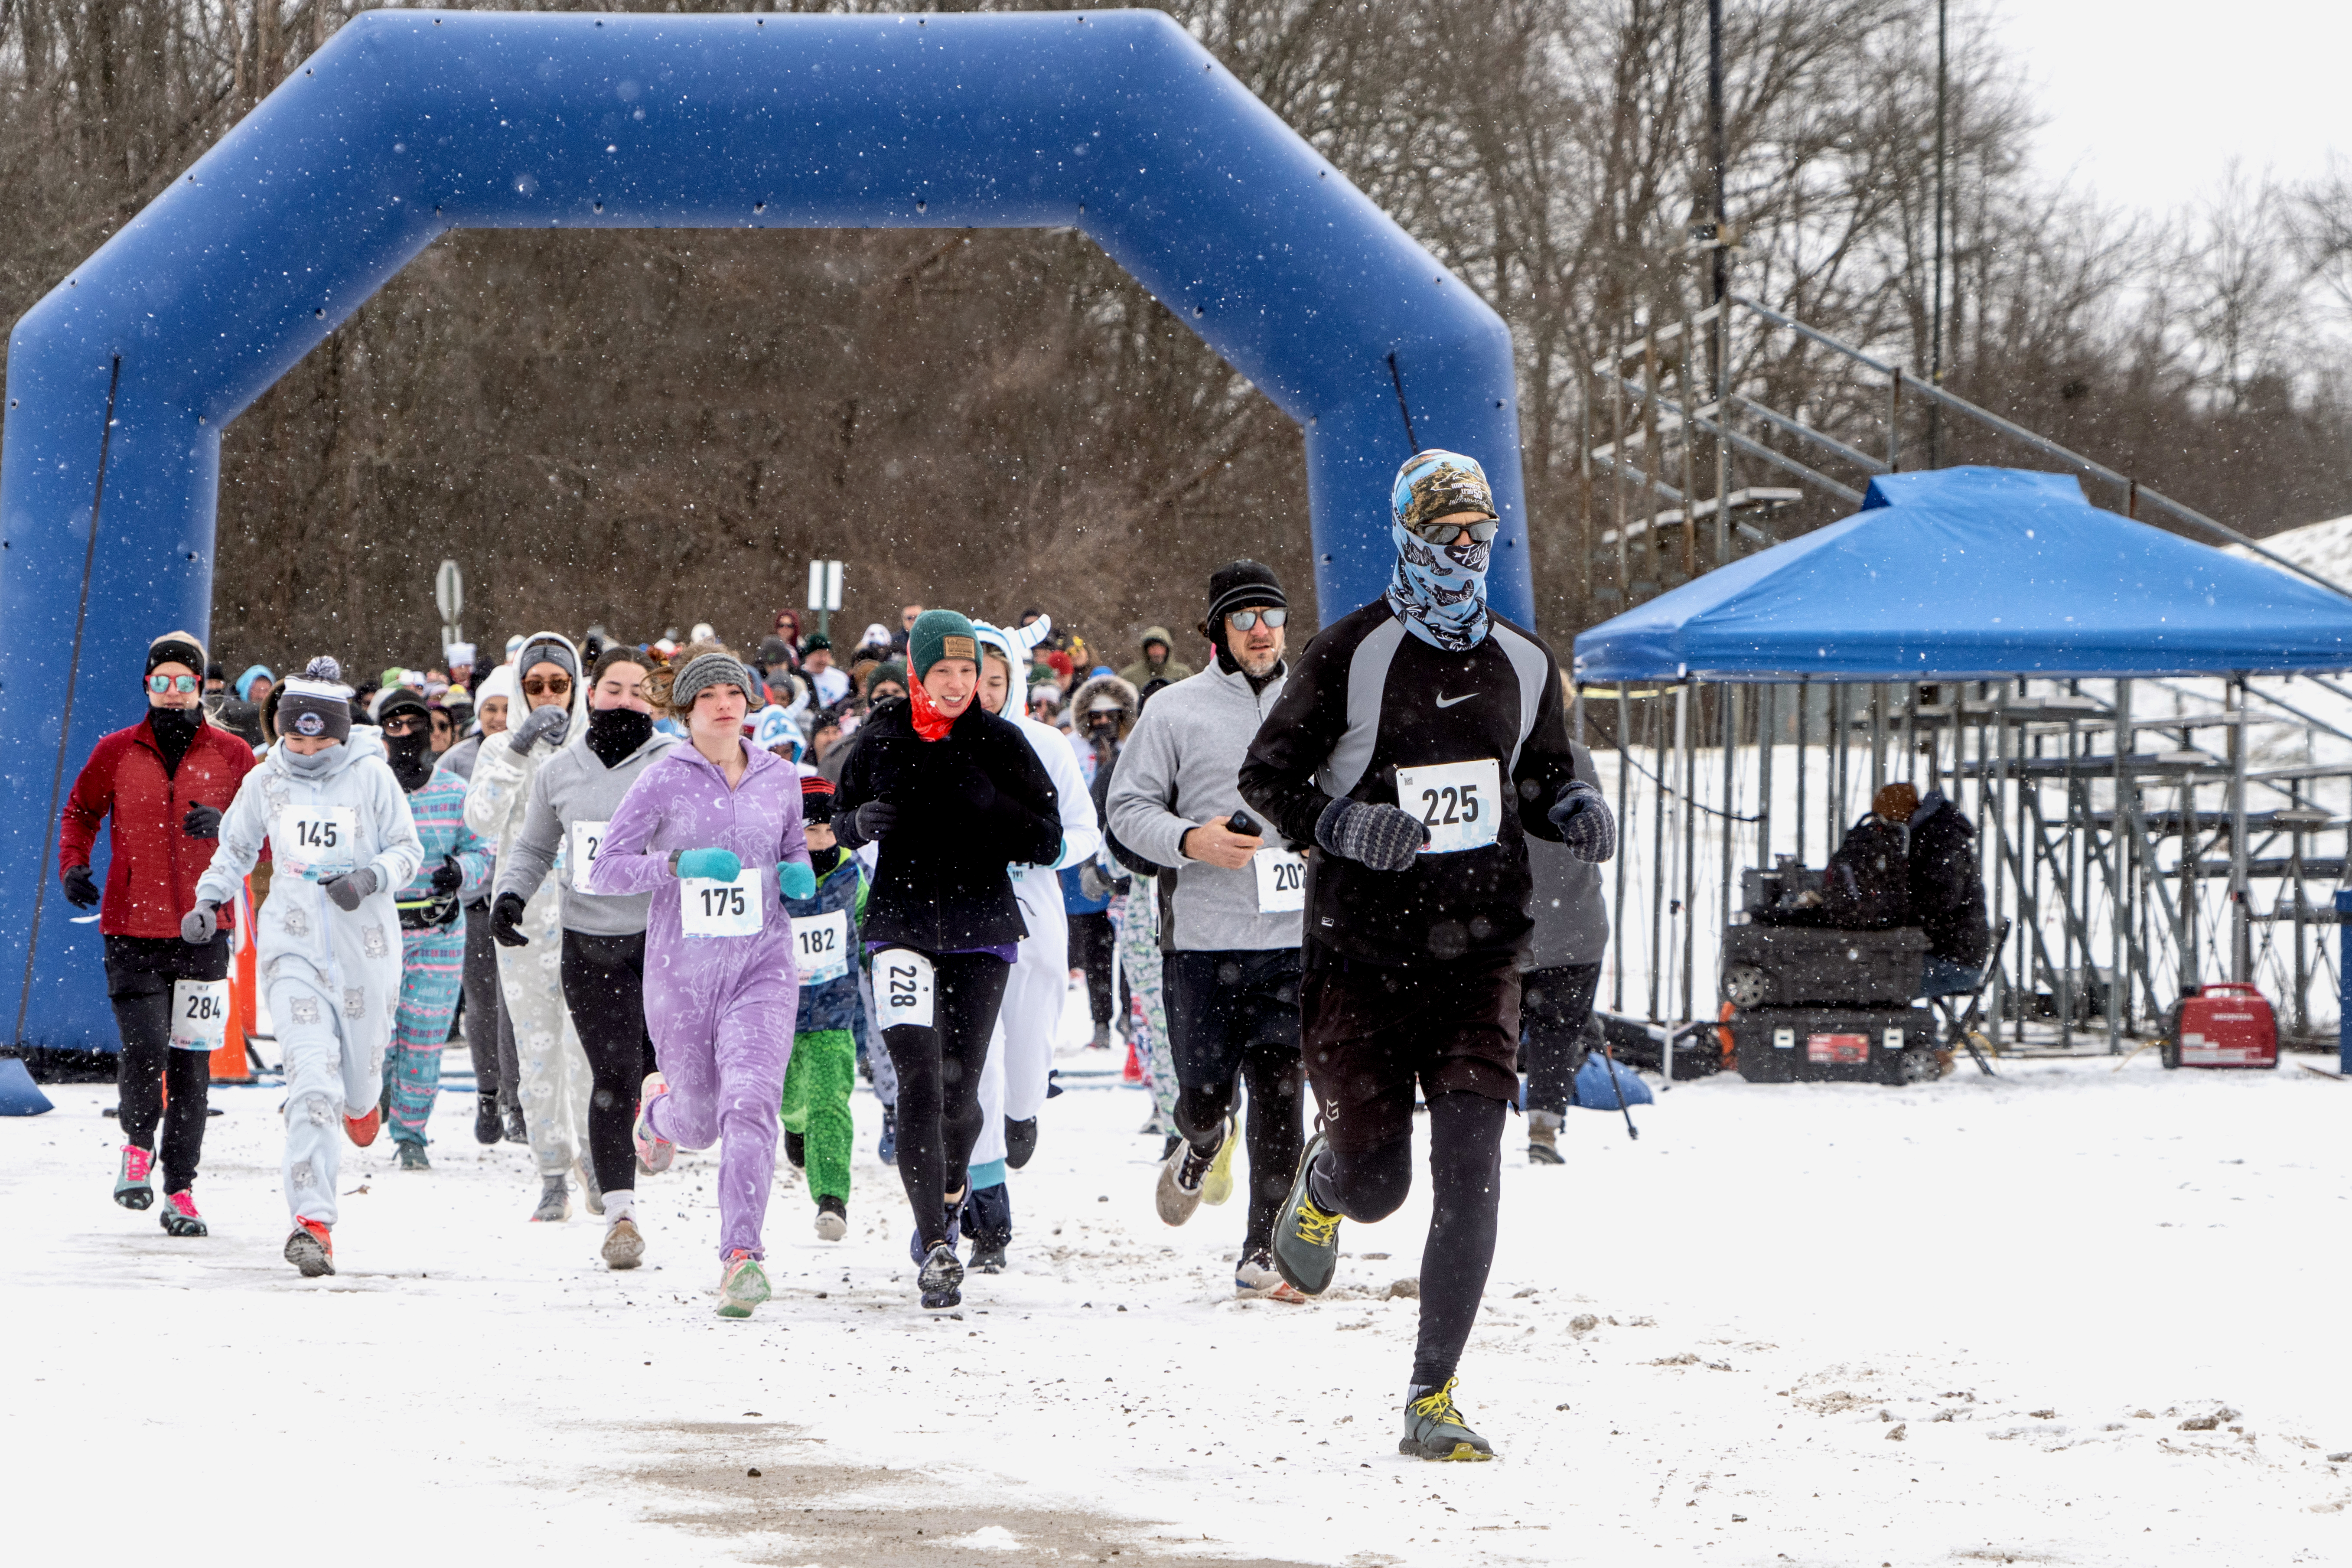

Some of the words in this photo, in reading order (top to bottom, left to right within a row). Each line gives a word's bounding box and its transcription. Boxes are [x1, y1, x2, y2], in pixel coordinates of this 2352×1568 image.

[1474, 489, 1482, 500] 50
[1422, 784, 1479, 826] 225
[297, 821, 337, 848] 145
[588, 836, 603, 861] 2
[700, 887, 745, 916] 175
[799, 928, 834, 954] 182
[890, 965, 917, 1007] 228
[186, 995, 220, 1019] 284
